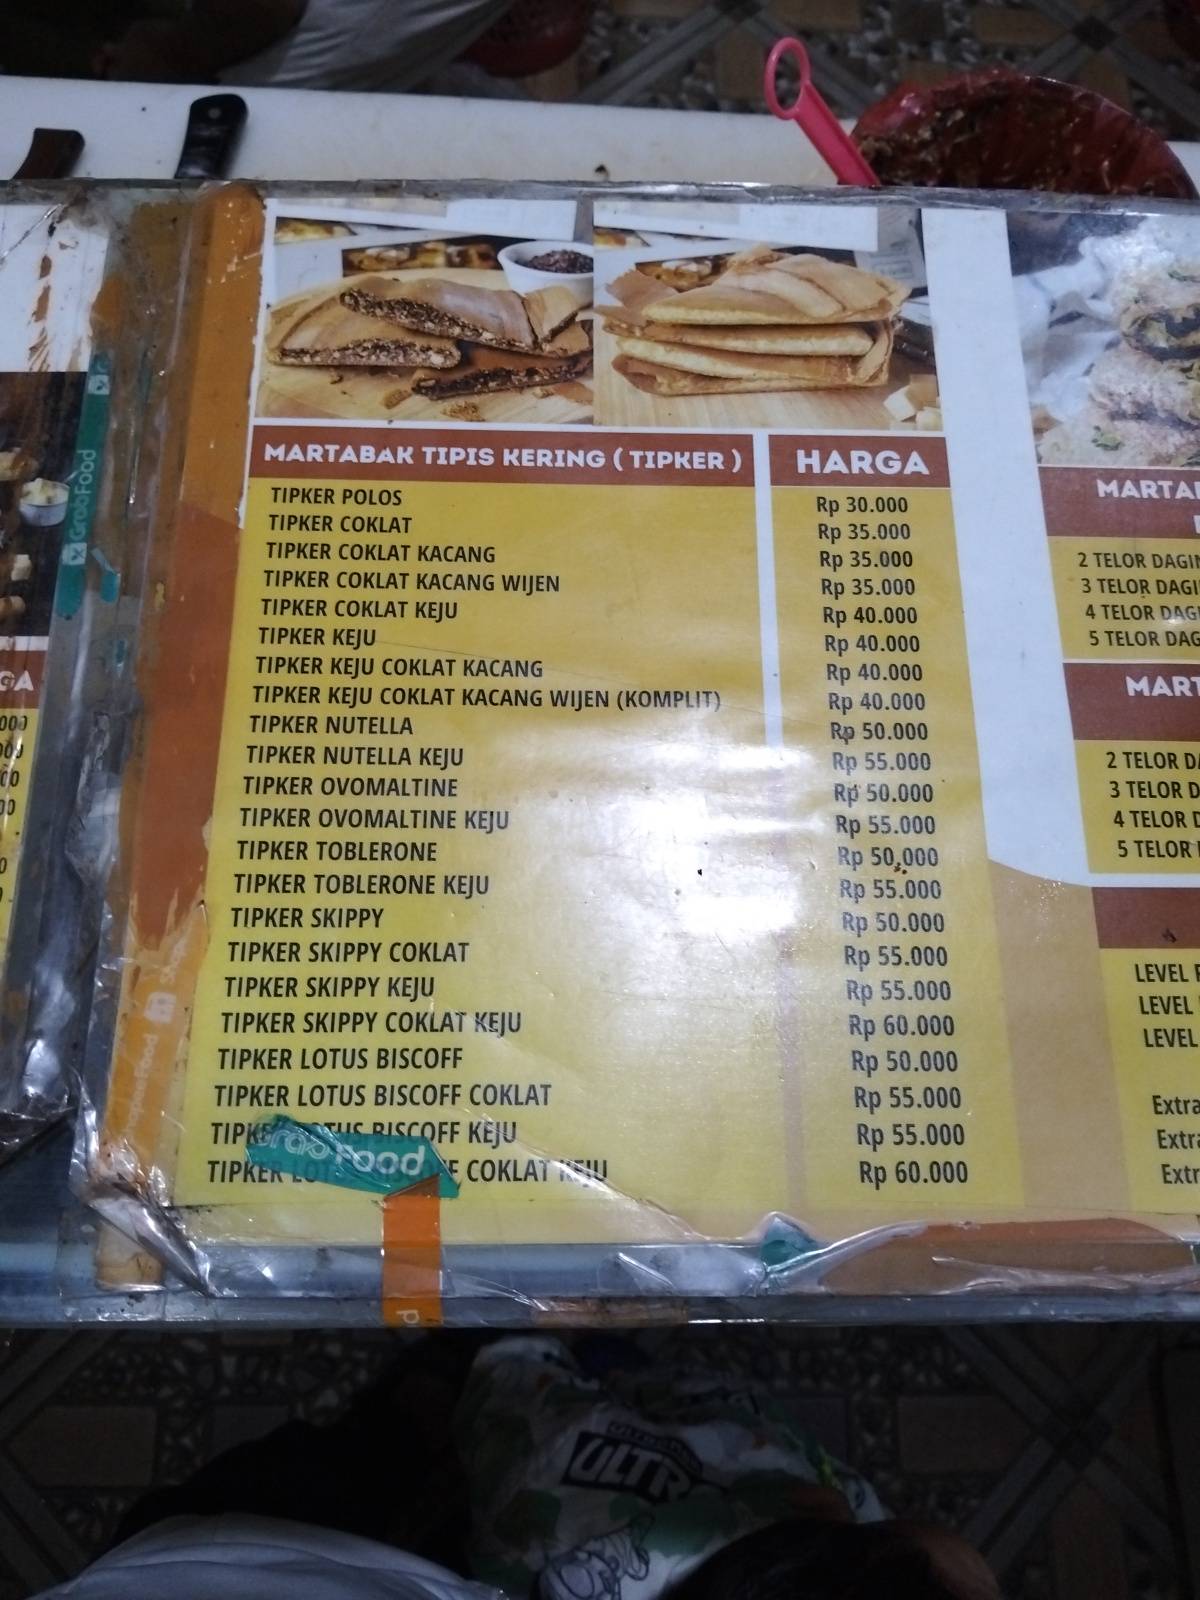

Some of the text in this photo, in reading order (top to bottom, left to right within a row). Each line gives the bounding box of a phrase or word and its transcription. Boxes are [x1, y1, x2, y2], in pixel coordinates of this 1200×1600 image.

[264, 442, 414, 466] MARTABAK
[422, 445, 495, 468] TIPIS
[502, 448, 606, 470] KERING
[796, 448, 930, 475] HARGA
[272, 488, 401, 506] TIPKER POLOS
[817, 497, 908, 517] Rp 30.000
[269, 515, 412, 533] TIPKER COKLAT
[818, 523, 910, 544] Rp 35.000
[267, 542, 495, 563] TIPKER COKLAT KACANG
[820, 551, 912, 572] Rp 35.000
[1078, 552, 1088, 568] 2
[1093, 552, 1147, 569] TELOR
[264, 570, 559, 596] TIPKER COKLAT KACANG WIJEN
[822, 579, 915, 600] Rp 35.000
[1081, 578, 1092, 594] 3
[1097, 578, 1151, 595] TELOR
[261, 599, 457, 623] TIPKER COKLAT KEJU
[824, 607, 917, 628] Rp 40.000
[1085, 604, 1155, 621] 4 TELOR
[259, 627, 375, 650] TIPKER KEJU
[825, 635, 919, 657] Rp 40.000
[1089, 630, 1099, 646] 5
[1104, 630, 1161, 647] TELOR
[256, 656, 542, 679] TIPKER KEJU COKLAT KACANG
[827, 664, 922, 686] Rp 40.000
[253, 686, 720, 711] TIPKER KEJU COKLAT KACANG WIJEN (KOMPLIT)
[829, 693, 925, 715] Rp 40.000
[250, 715, 413, 734] TIPKER NUTELLA
[831, 722, 927, 745] Rp 50.000
[247, 746, 463, 770] TIPKER NUTELLA KEJU
[833, 752, 931, 775] Rp 55.000
[1106, 751, 1179, 769] 2 TELOR
[244, 776, 457, 796] TIPKER OVOMALTINE
[835, 784, 933, 808] Rp 50.000
[1109, 781, 1120, 799] 3
[1126, 780, 1183, 799] TELOR
[240, 808, 508, 834] TIPKER OVOMALTINE KEJU
[836, 815, 935, 839] Rp 55.000
[1113, 810, 1187, 828] 4 TELOR
[237, 841, 436, 861] TIPKER TOBLERONE
[838, 847, 862, 871] Rp
[1117, 840, 1128, 858] 5
[1133, 840, 1192, 859] TELOR
[234, 874, 488, 899] TIPKER TOBLERONE KEJU
[840, 879, 941, 904] Rp 55.000
[231, 908, 384, 928] TIPKER SKIPPY
[843, 912, 944, 937] Rp 50.000
[228, 942, 469, 962] TIPKER SKIPPY COKLAT
[845, 946, 947, 972] Rp 55.000
[1134, 963, 1189, 983] LEVEL
[225, 977, 434, 1002] TIPKER SKIPPY KEJU
[847, 980, 951, 1006] Rp 55.000
[1138, 995, 1194, 1015] LEVEL
[222, 1012, 520, 1037] TIPKER SKIPPY COKLAT KEJU
[849, 1015, 954, 1041] Rp 60.000
[1143, 1028, 1199, 1047] LEVEL
[218, 1048, 462, 1069] TIPKER LOTUS BISCOFF
[852, 1050, 957, 1078] Rp 50.000
[215, 1084, 551, 1106] TIPKER LOTUS BISCOFF COKLAT
[855, 1087, 961, 1115] Rp 55.000
[211, 1122, 286, 1145] TIPKE
[469, 1122, 517, 1150] KEJU
[857, 1124, 964, 1152] Rp 55.000
[467, 1160, 550, 1182] COKLAT
[860, 1161, 967, 1189] Rp 60.000
